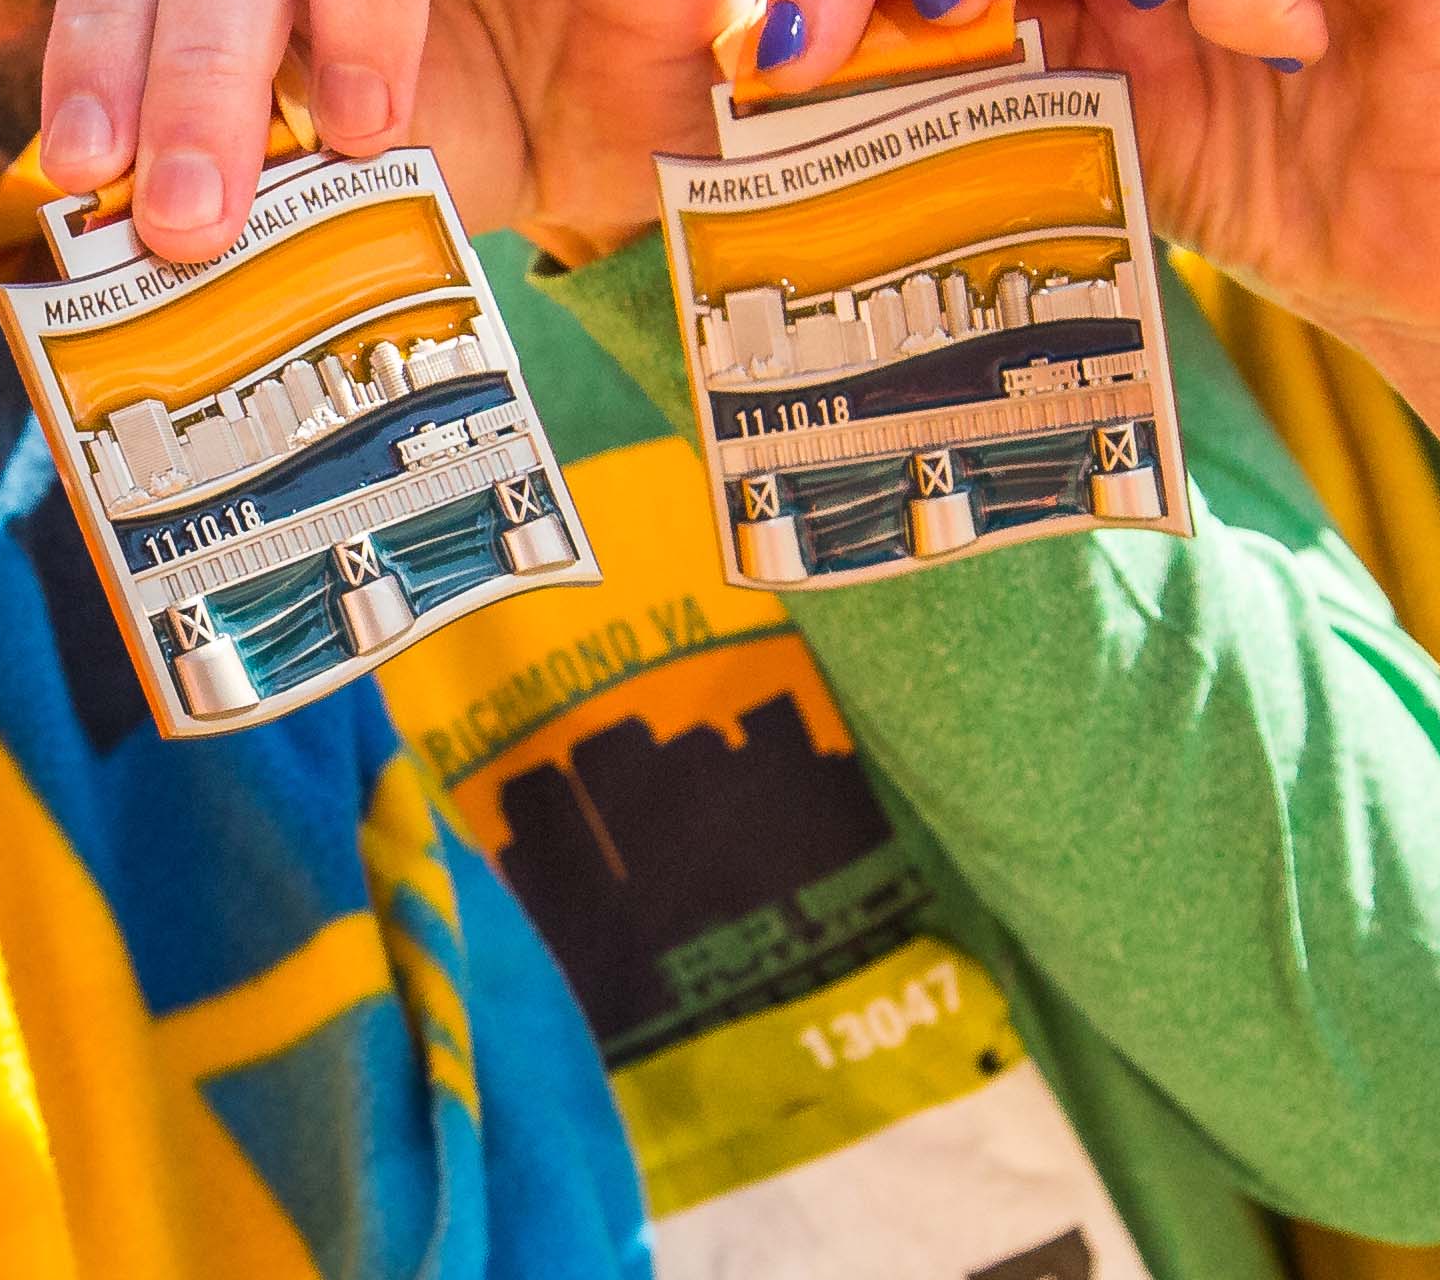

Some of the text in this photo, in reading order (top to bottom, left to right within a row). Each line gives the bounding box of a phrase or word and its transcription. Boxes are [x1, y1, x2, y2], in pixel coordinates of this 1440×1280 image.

[687, 90, 1102, 204] MARKEL RICHMOND HALF MARATHON
[42, 162, 421, 327] MARKEL RICHD HALF MARATHON
[736, 395, 851, 439] 11.10.18
[144, 499, 263, 566] 11.10.18
[423, 594, 716, 776] RICHMOND VA
[800, 962, 963, 1071] 13047
